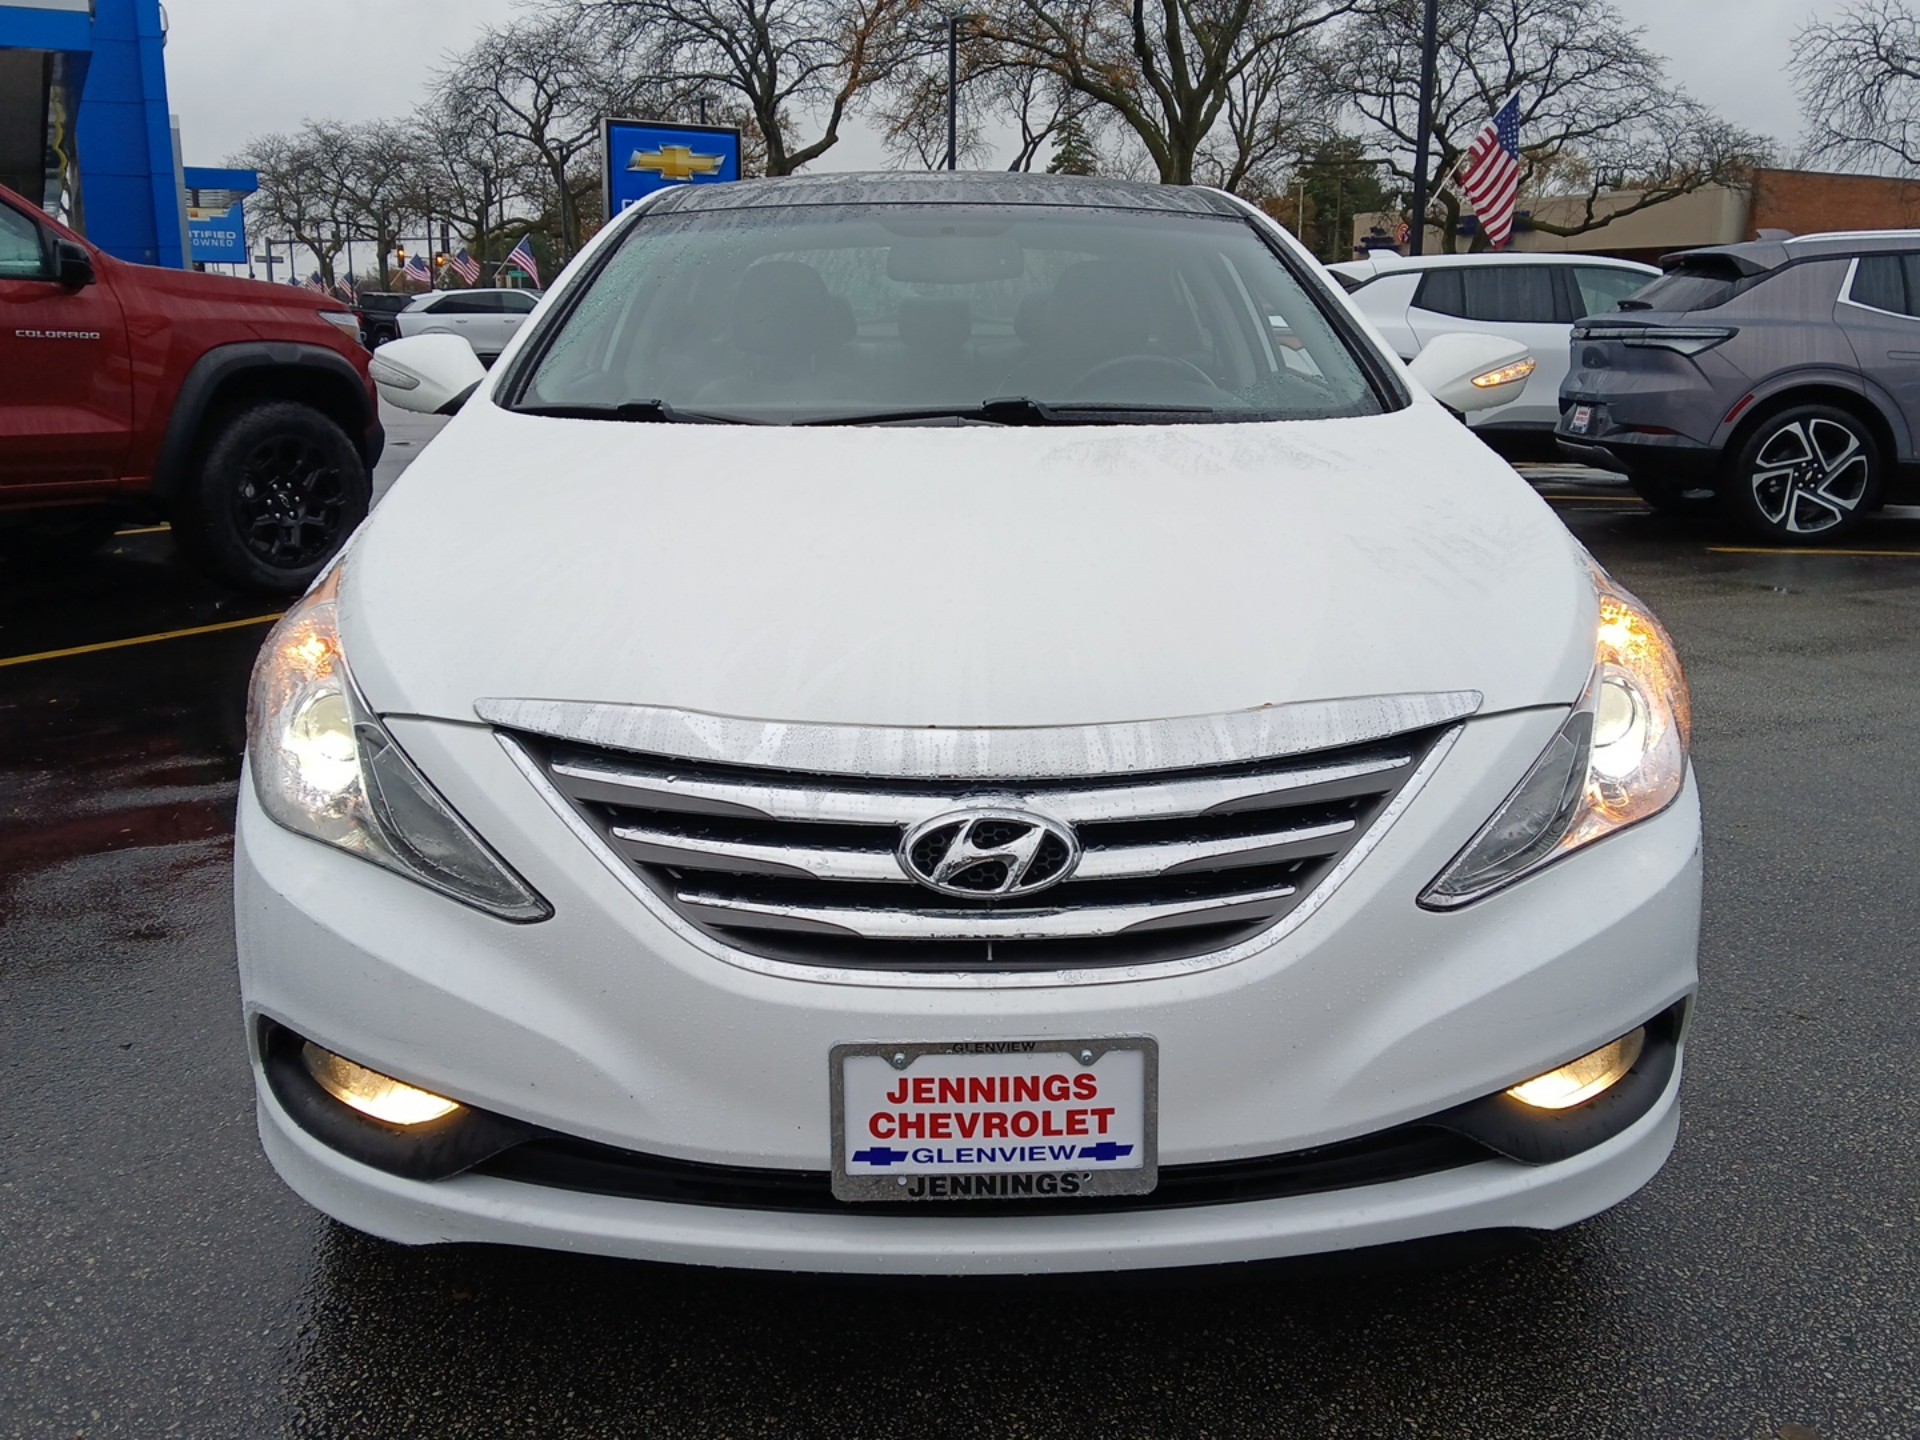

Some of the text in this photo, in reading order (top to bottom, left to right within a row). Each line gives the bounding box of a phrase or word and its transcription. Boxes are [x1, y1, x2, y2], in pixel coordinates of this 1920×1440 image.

[15, 329, 100, 340] COLORADO
[952, 1041, 1036, 1054] GLENVIEW
[886, 1073, 1098, 1105] JENNINGS
[868, 1107, 1116, 1139] CHEVROLET
[911, 1144, 1078, 1164] GLENVIEW
[907, 1173, 1081, 1198] JENNINGS
